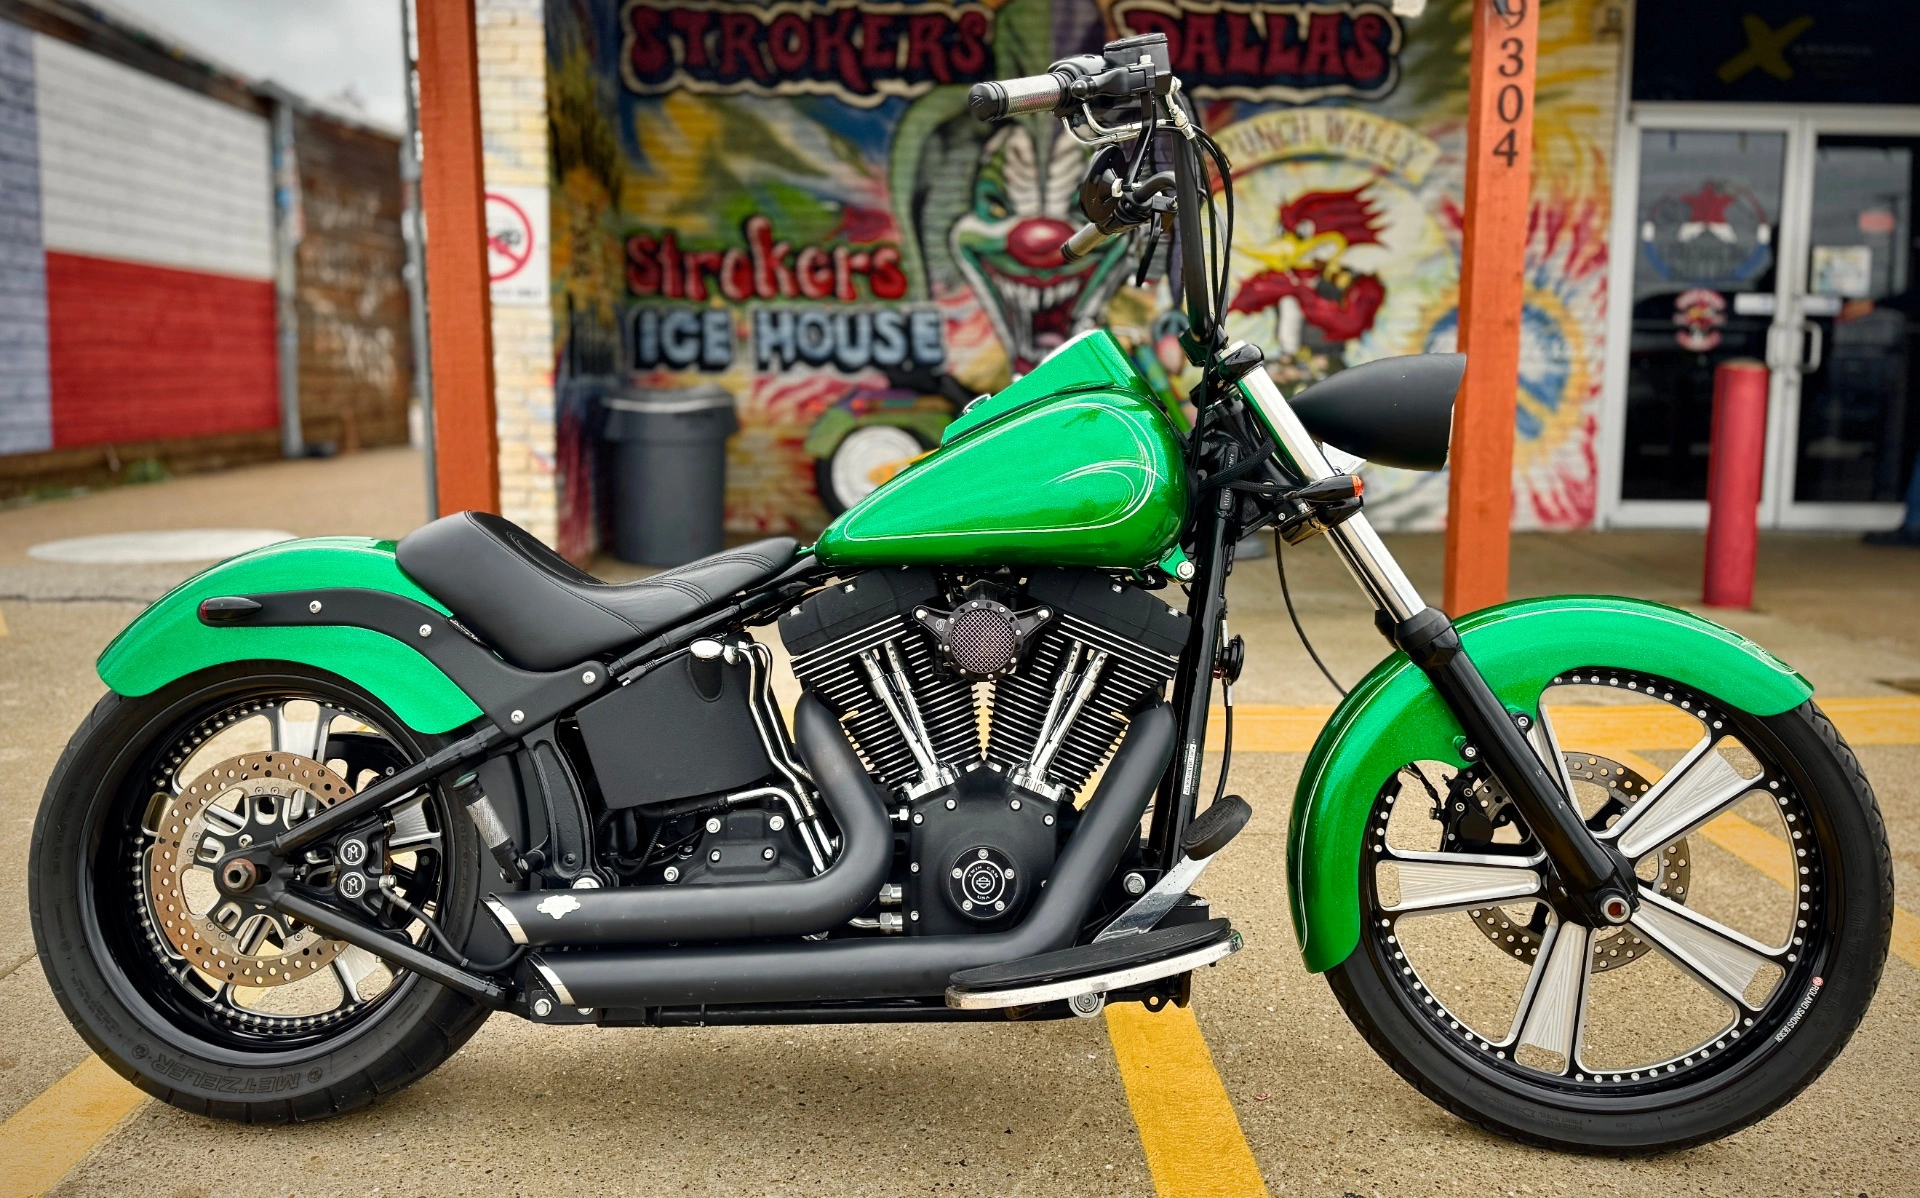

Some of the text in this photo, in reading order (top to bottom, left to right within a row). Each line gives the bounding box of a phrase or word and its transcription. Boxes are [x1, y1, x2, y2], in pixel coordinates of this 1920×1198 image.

[630, 5, 988, 91] STROKERS
[1492, 0, 1528, 168] 9304
[626, 215, 908, 301] Strokers
[636, 308, 945, 369] ICE HOUSE
[967, 865, 999, 879] TWIN CAM
[1823, 903, 1866, 1017] METZELER
[1774, 984, 1820, 1043] ROLAND SANDS DESIGN
[151, 1052, 301, 1094] METZELER
